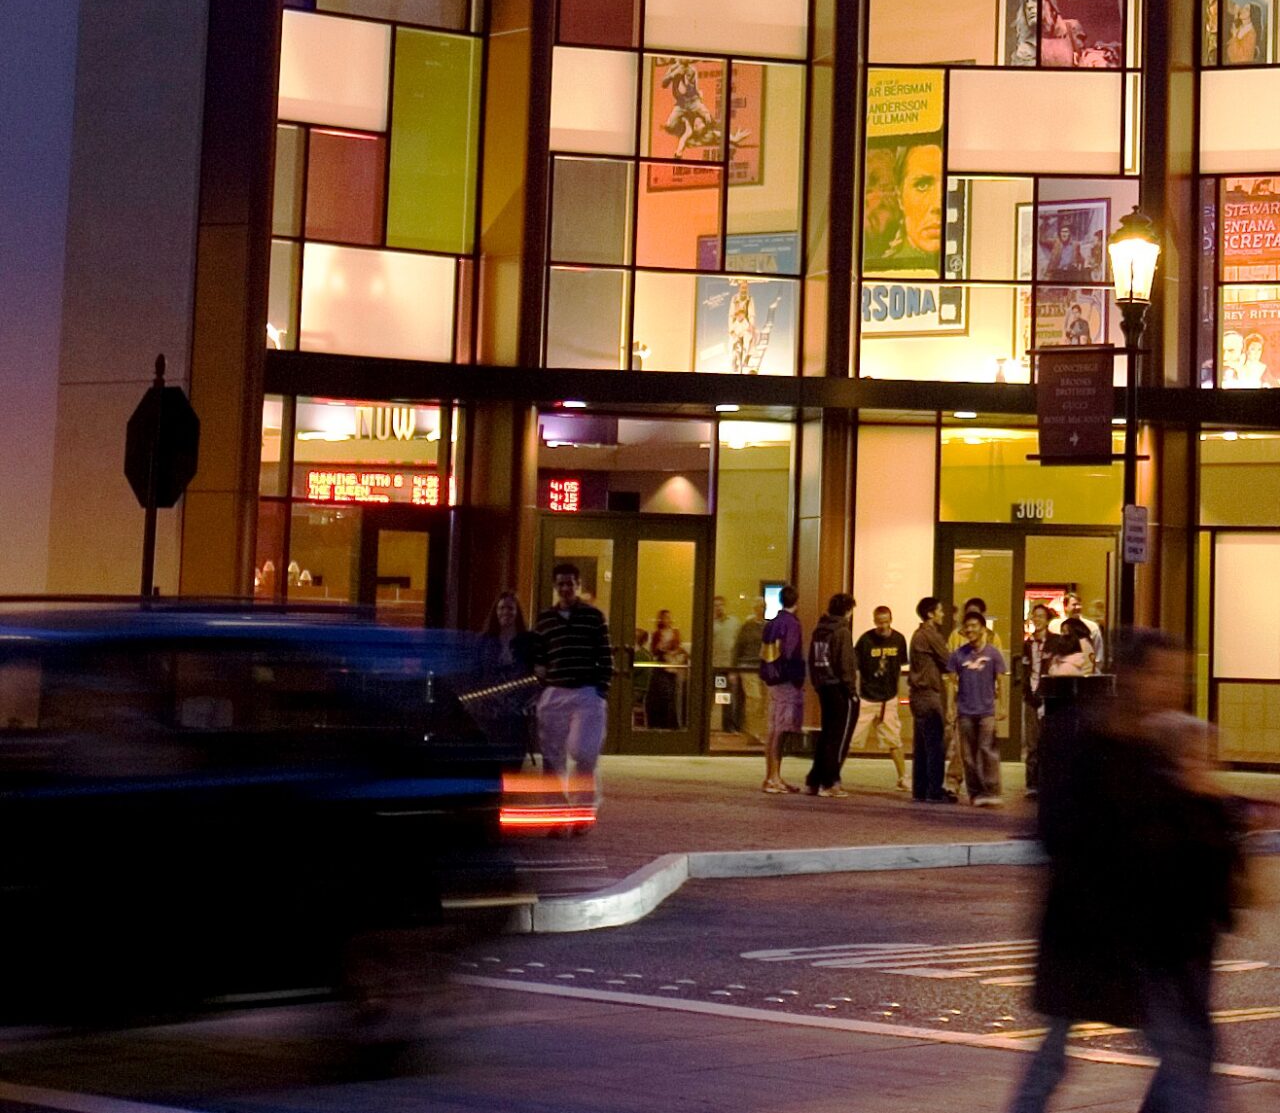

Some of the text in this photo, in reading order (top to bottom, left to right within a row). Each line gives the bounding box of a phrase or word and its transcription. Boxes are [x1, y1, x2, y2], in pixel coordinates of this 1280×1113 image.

[884, 82, 932, 96] BERGMAN
[869, 99, 928, 114] ANDERSSON
[873, 112, 919, 125] ULLMANN
[334, 486, 370, 497] QUEEN
[1016, 498, 1054, 519] 3088
